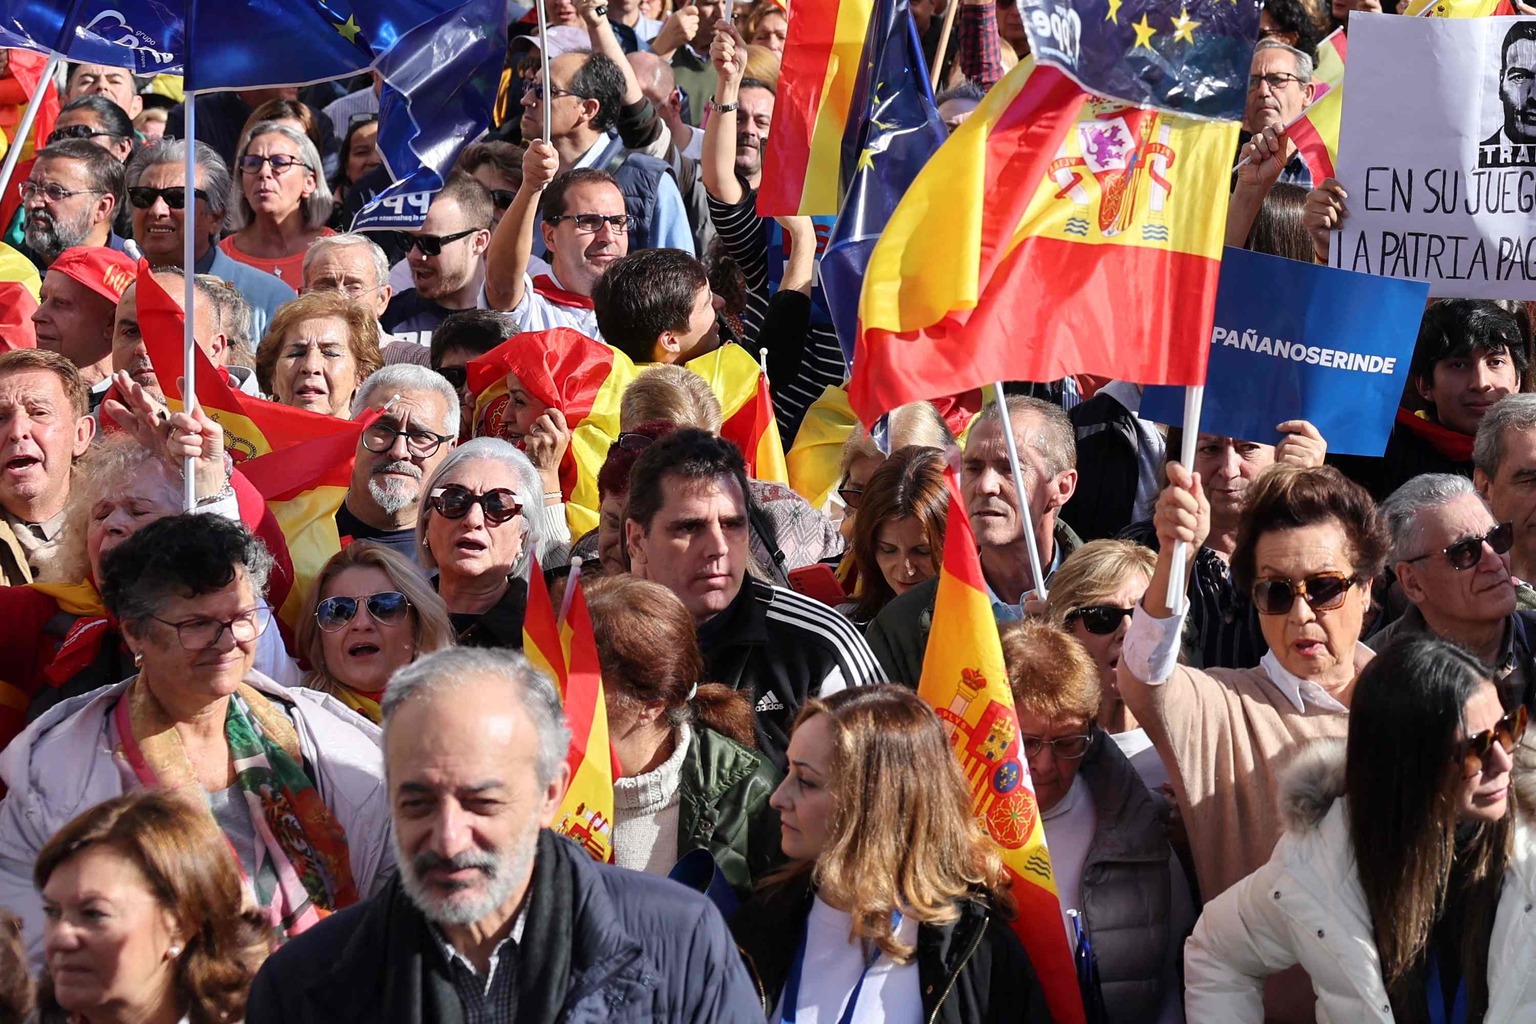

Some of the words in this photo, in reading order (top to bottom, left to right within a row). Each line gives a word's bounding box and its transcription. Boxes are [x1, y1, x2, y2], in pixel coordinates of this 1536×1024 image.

[135, 30, 156, 46] grupo
[1364, 167, 1413, 213] EN
[1423, 168, 1458, 214] SU
[1381, 231, 1488, 280] PATRIA
[754, 703, 784, 712] adidas
